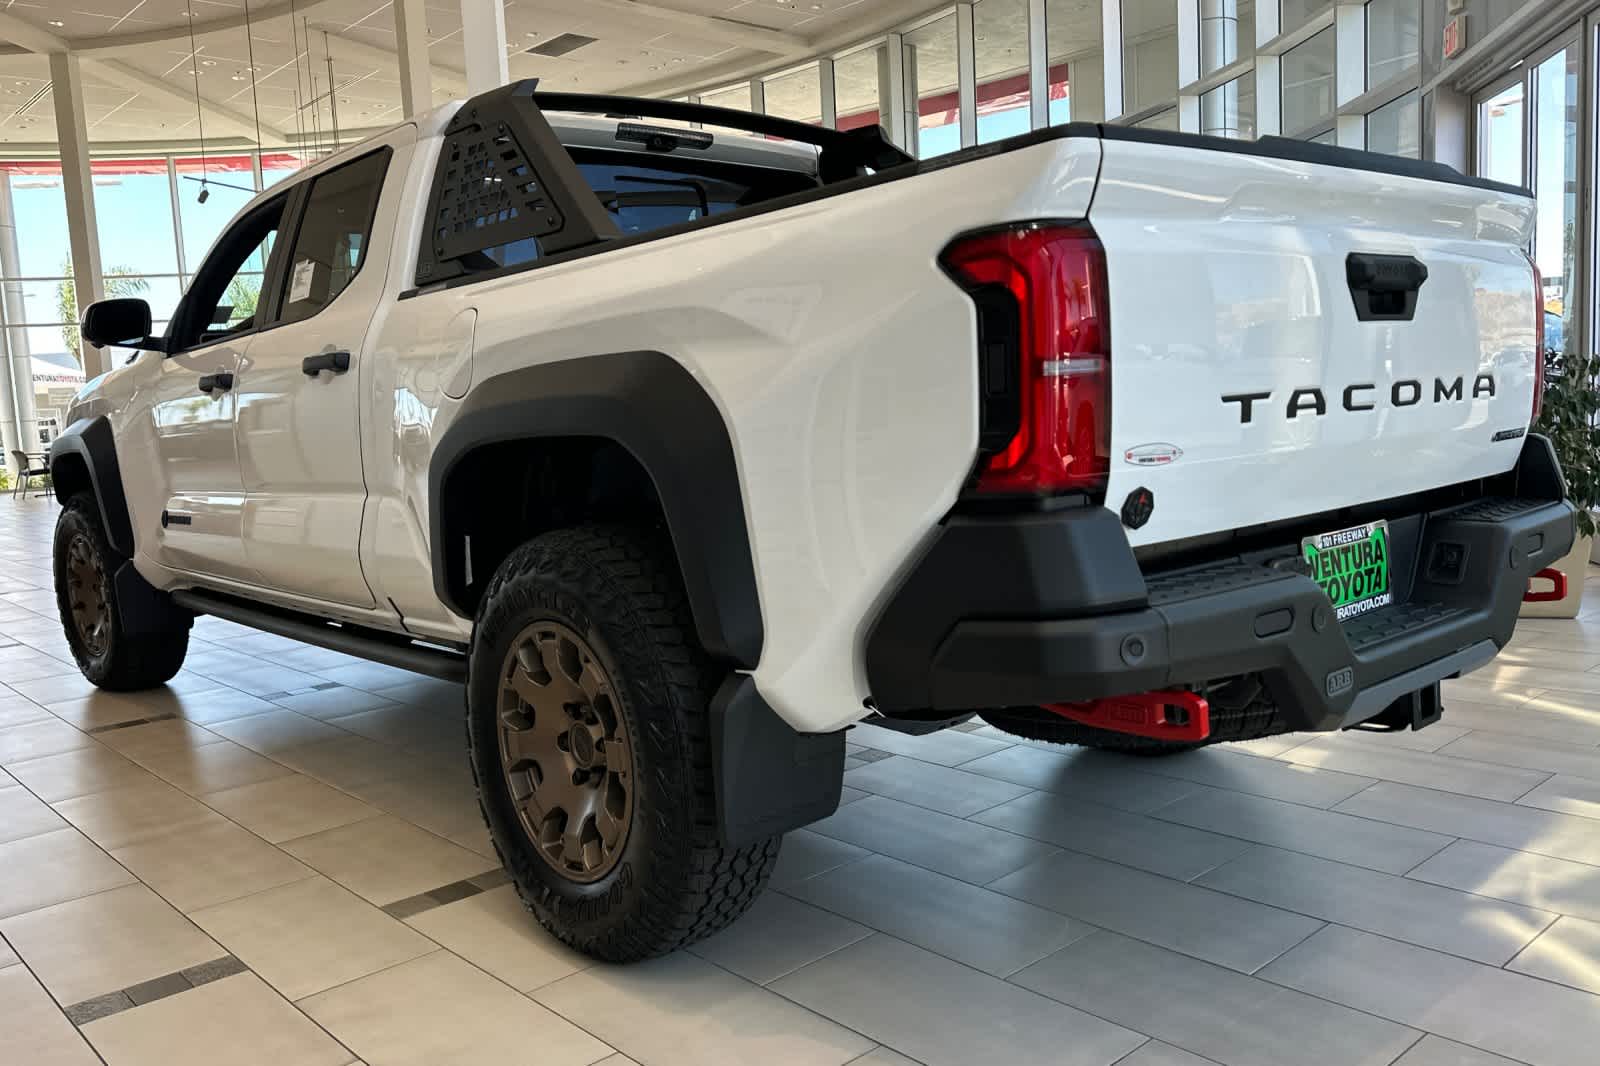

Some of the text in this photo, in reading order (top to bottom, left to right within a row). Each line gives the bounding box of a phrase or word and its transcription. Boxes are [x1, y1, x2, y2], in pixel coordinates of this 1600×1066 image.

[1221, 374, 1497, 424] TACOMA
[1322, 527, 1367, 548] 101 FREEWAY
[1308, 538, 1384, 581] VENTURA
[1336, 593, 1390, 619] RATOYOTA.COM
[1329, 671, 1351, 693] ARB
